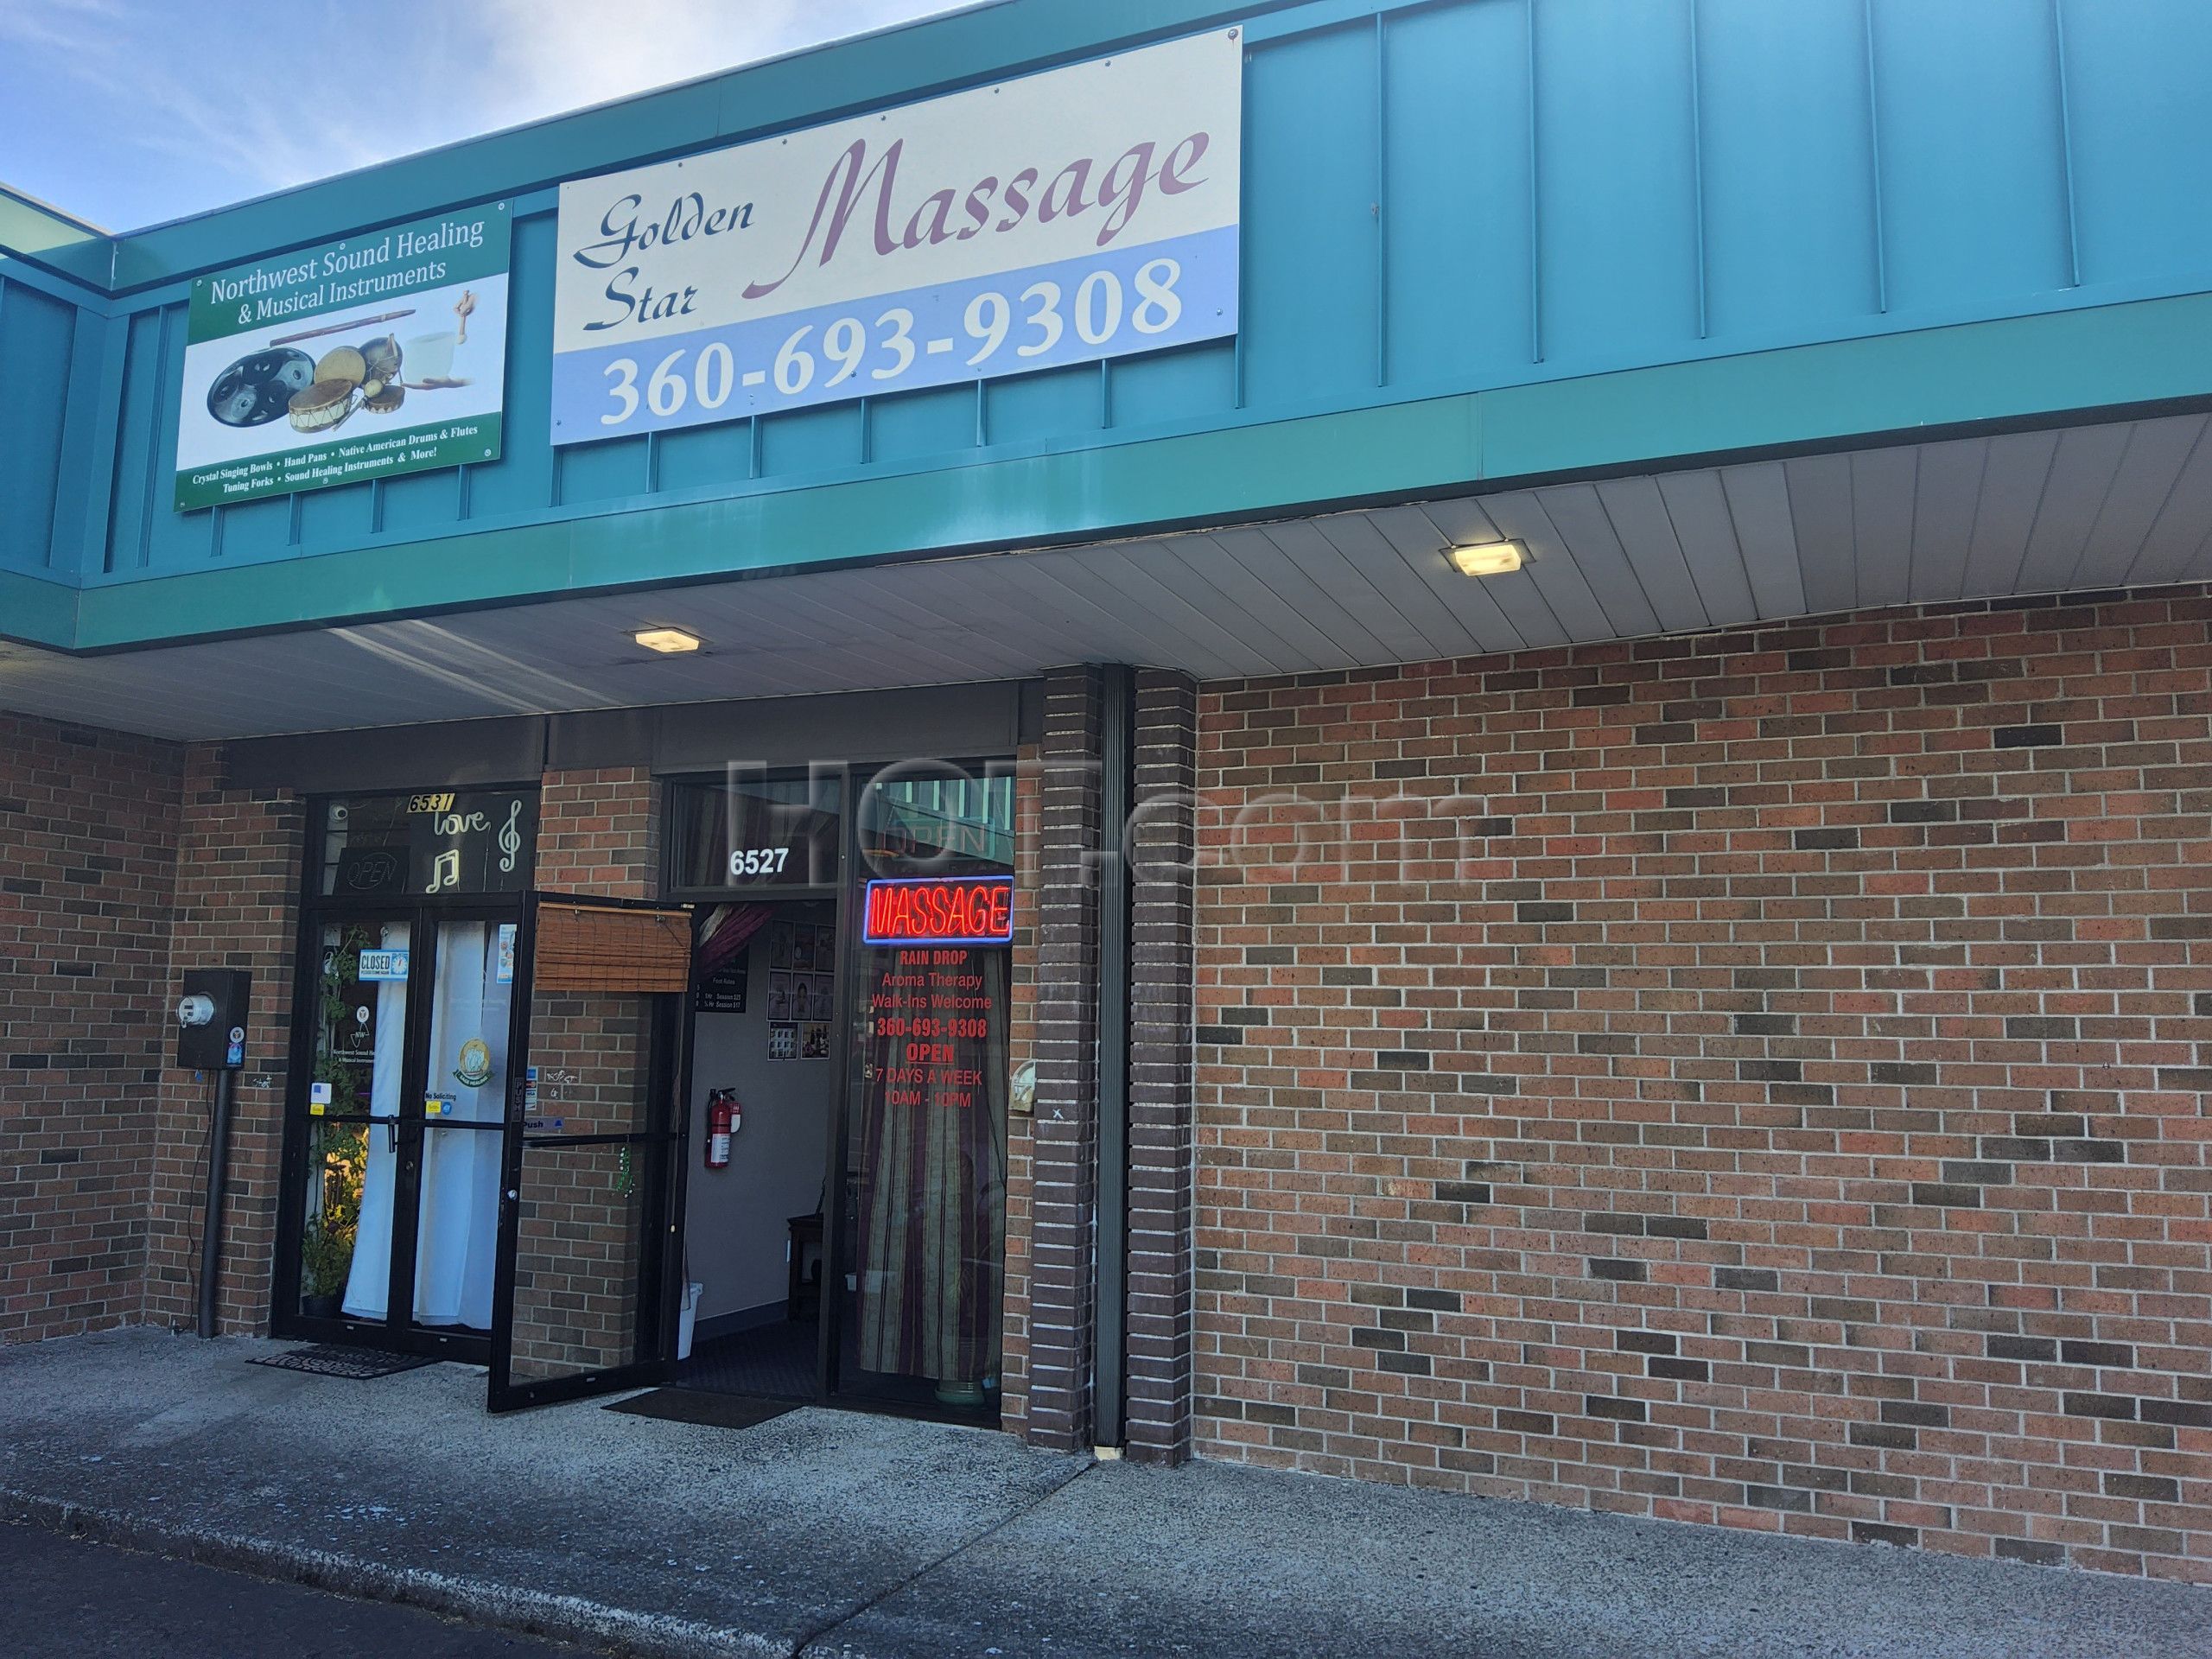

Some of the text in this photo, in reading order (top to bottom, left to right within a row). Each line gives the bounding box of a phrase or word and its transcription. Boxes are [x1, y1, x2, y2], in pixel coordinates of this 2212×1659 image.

[741, 130, 1211, 300] Massage
[573, 192, 755, 268] Golden
[210, 220, 485, 304] Northwest Sound Healing
[238, 260, 447, 325] & Musical Instruments
[582, 265, 699, 331] Star
[601, 257, 1182, 425] 360-693-9308
[192, 424, 478, 486] Crystal Singing Bowls Hand Pans Native American Drums & Flutes
[222, 446, 437, 494] Tuning Forks Sound Healing Instruments & More!
[410, 794, 453, 812] 6531
[882, 823, 985, 856] OPEN
[729, 847, 789, 876] 6527
[868, 885, 1010, 937] MASSAGE
[361, 955, 390, 969] CLOSED
[899, 950, 967, 965] RAIN DROP
[881, 973, 982, 990] Aroma Therapy
[872, 994, 992, 1010] Walk-Ins Welcome
[877, 1018, 987, 1038] 360-693-9308
[906, 1042, 955, 1063] OPEN
[876, 1068, 982, 1085] 7 DAYS A WEEK
[432, 1092, 456, 1102] Soliciting
[885, 1090, 921, 1106] 10AM
[933, 1091, 971, 1108] 10PM
